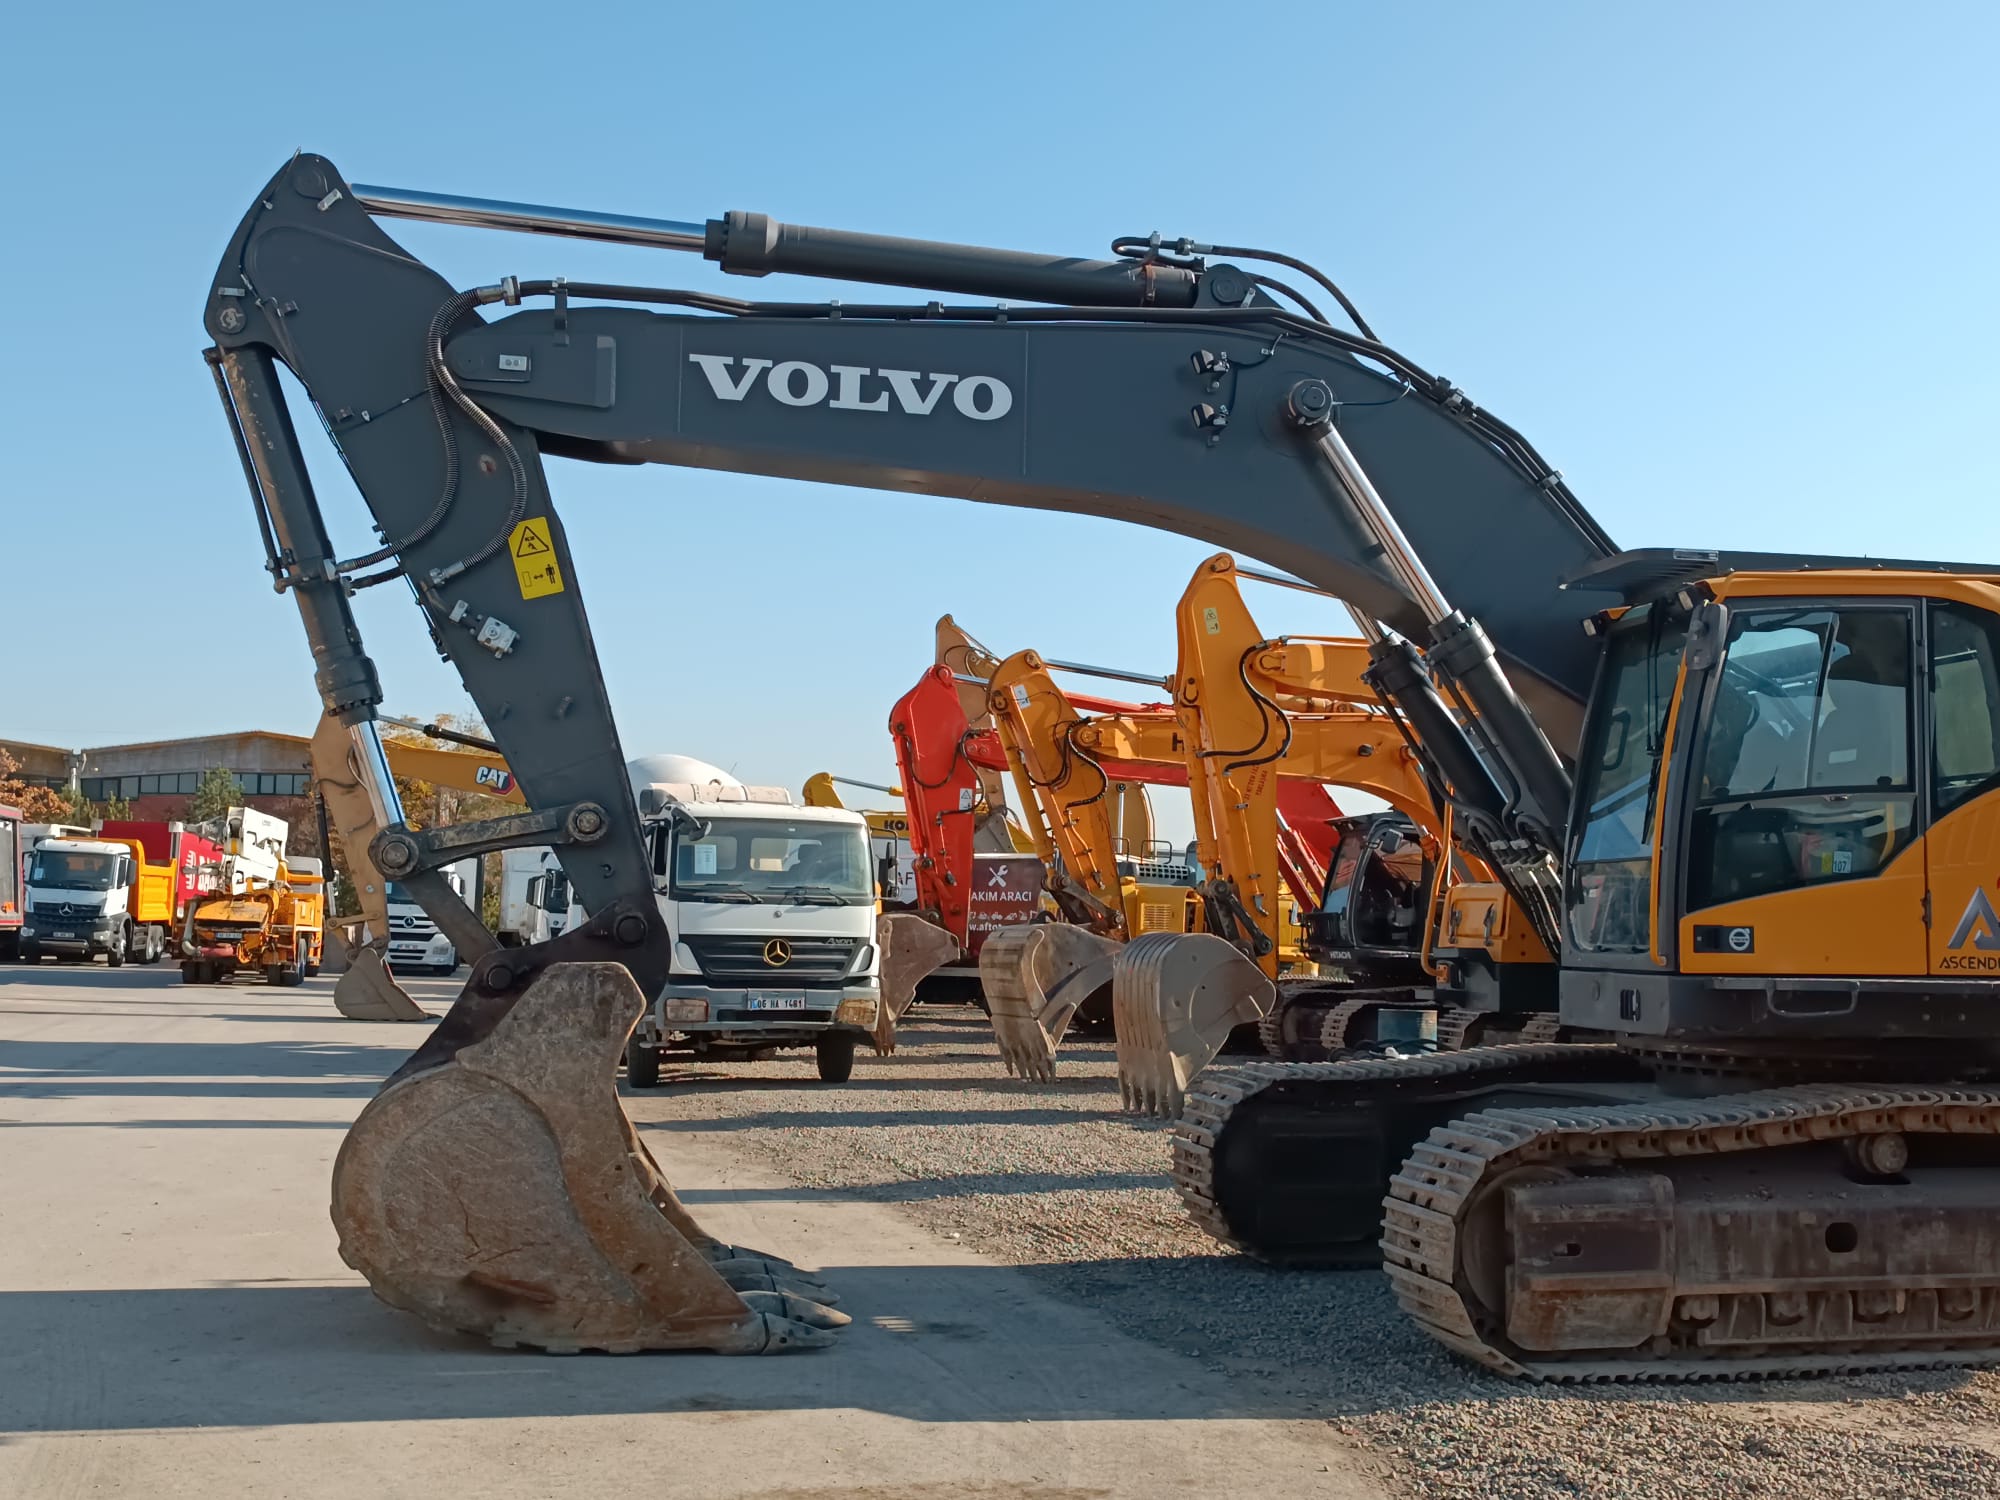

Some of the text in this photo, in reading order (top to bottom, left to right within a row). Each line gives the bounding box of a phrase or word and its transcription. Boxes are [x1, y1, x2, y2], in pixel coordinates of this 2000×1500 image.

[689, 353, 1013, 421] VOLVO
[476, 766, 508, 789] CAT
[1000, 891, 1032, 902] ARACI
[1939, 956, 2000, 970] ASCEND
